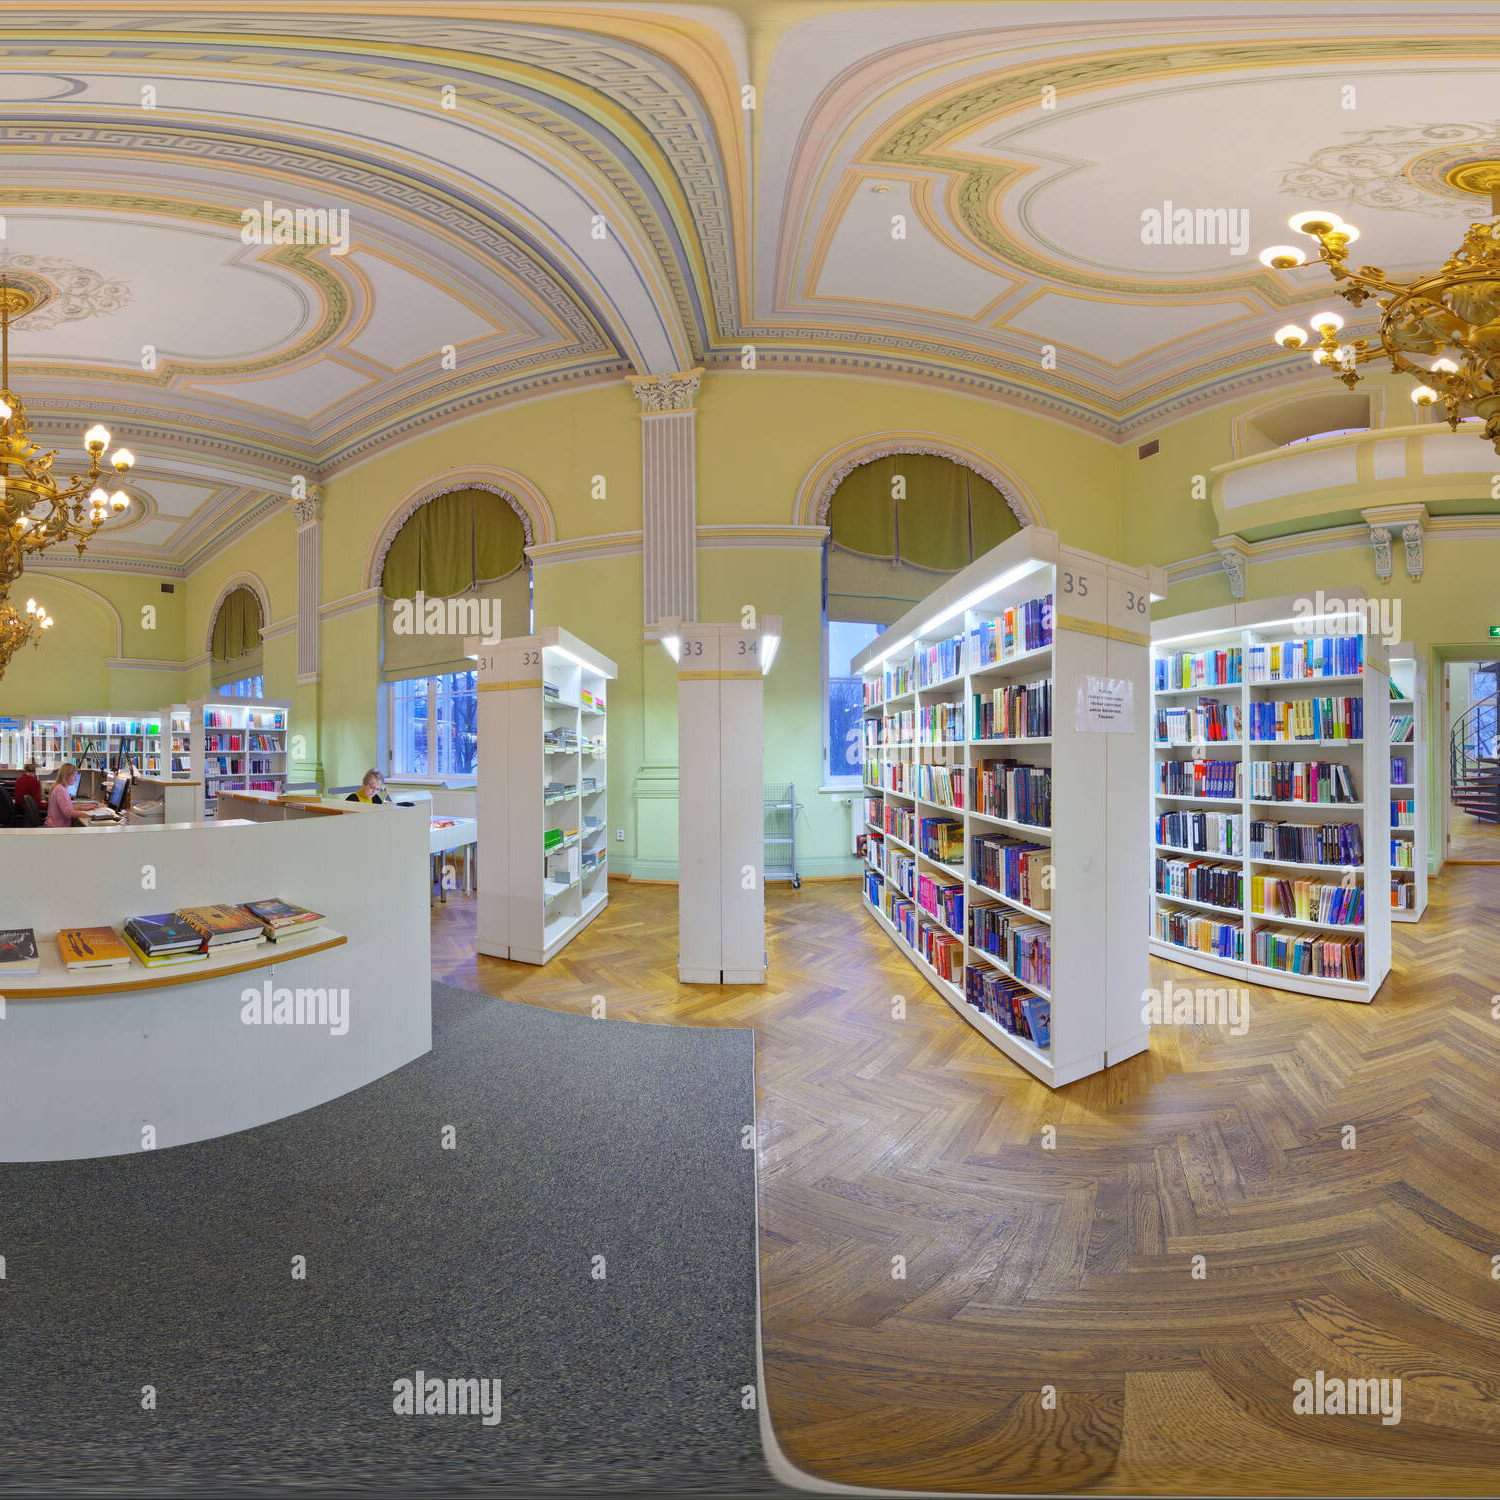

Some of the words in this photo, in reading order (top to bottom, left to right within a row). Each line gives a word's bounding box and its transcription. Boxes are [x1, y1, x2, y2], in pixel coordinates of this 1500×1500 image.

[1063, 572, 1088, 597] 35
[1126, 591, 1146, 614] 36
[683, 641, 703, 656] 33
[738, 640, 757, 655] 34
[480, 656, 493, 670] 31
[523, 651, 540, 666] 32
